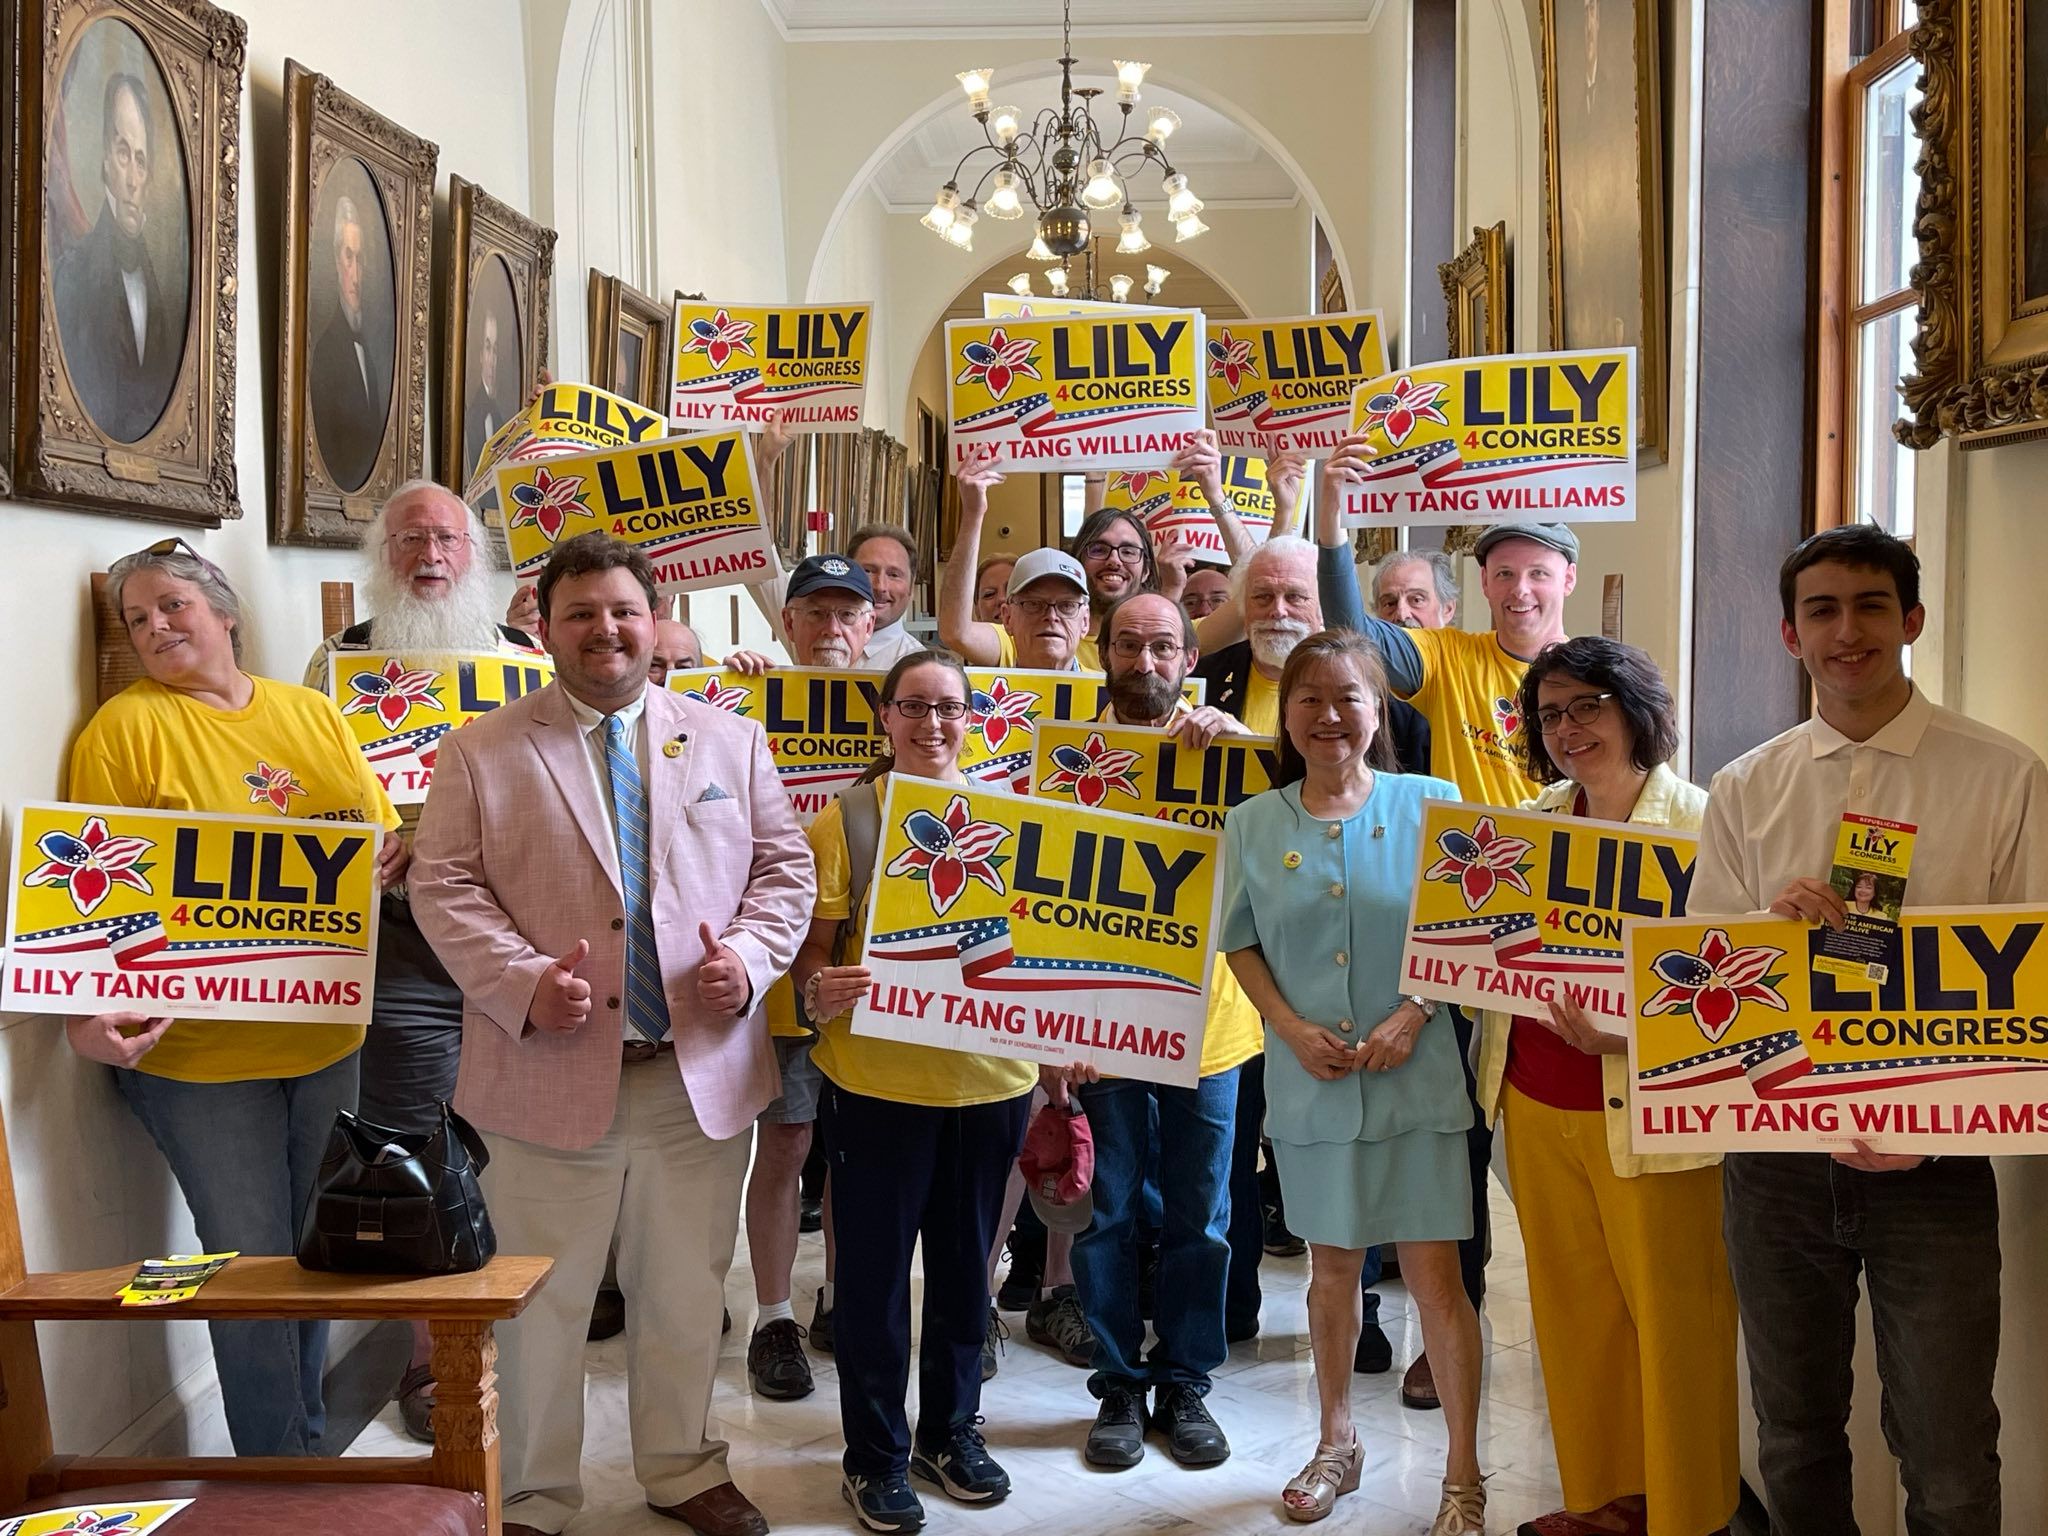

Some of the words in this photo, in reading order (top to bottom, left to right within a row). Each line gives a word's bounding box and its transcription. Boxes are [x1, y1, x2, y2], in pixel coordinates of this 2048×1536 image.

[767, 312, 864, 359] LILY
[1052, 321, 1187, 380] LILY
[1262, 322, 1371, 380] LILY
[765, 360, 861, 378] 4CONGRESS
[1056, 378, 1191, 402] 4CONGRESS
[1271, 377, 1379, 401] 4CONGR
[1464, 362, 1621, 426] LILY
[540, 388, 657, 443] LILY
[676, 402, 715, 420] LILY
[721, 404, 775, 423] TANG
[780, 405, 859, 423] WILLIAMS
[539, 421, 630, 448] 4CONGR
[1007, 438, 1072, 459] TANG
[1077, 432, 1196, 456] WILLIAMS
[1218, 430, 1247, 448] LILY
[1292, 430, 1347, 449] WILL
[1464, 426, 1621, 450] 4CONGRESS
[597, 439, 736, 516] LILY
[1348, 492, 1397, 515] LILY
[1405, 490, 1482, 513] TANG
[1488, 486, 1625, 511] WILLIAMS
[611, 498, 751, 536] 4CONGRESS
[654, 549, 767, 585] WILLIAMS
[458, 661, 556, 712] LIL
[767, 737, 883, 758] 4CONGRE
[401, 770, 433, 790] TA
[1859, 817, 1901, 829] REPUBLICAN
[1849, 850, 1897, 864] 4CONGRESS
[1850, 832, 1900, 856] LILY
[172, 827, 367, 905] LILY
[1013, 821, 1206, 917] LILY
[1547, 831, 1698, 918] LILY
[170, 904, 362, 934] 4CONGRESS
[1009, 897, 1198, 949] 4CONGRESS
[1857, 921, 1894, 934] AMERICAN
[1808, 923, 2045, 1012] LILY
[13, 967, 83, 996] LILY
[90, 971, 185, 1000] TANG
[195, 976, 361, 1006] WILLIAMS
[1408, 955, 1467, 987] LILY
[1473, 966, 1555, 1002] TANG
[1563, 981, 1627, 1018] WILL
[869, 982, 936, 1019] LILY
[941, 993, 1026, 1035] TANG
[1034, 1008, 1186, 1061] WILLIAMS
[1812, 1017, 2048, 1046] 4CONGRESS
[1643, 1104, 1720, 1134] LILY
[1728, 1103, 1839, 1133] TANG
